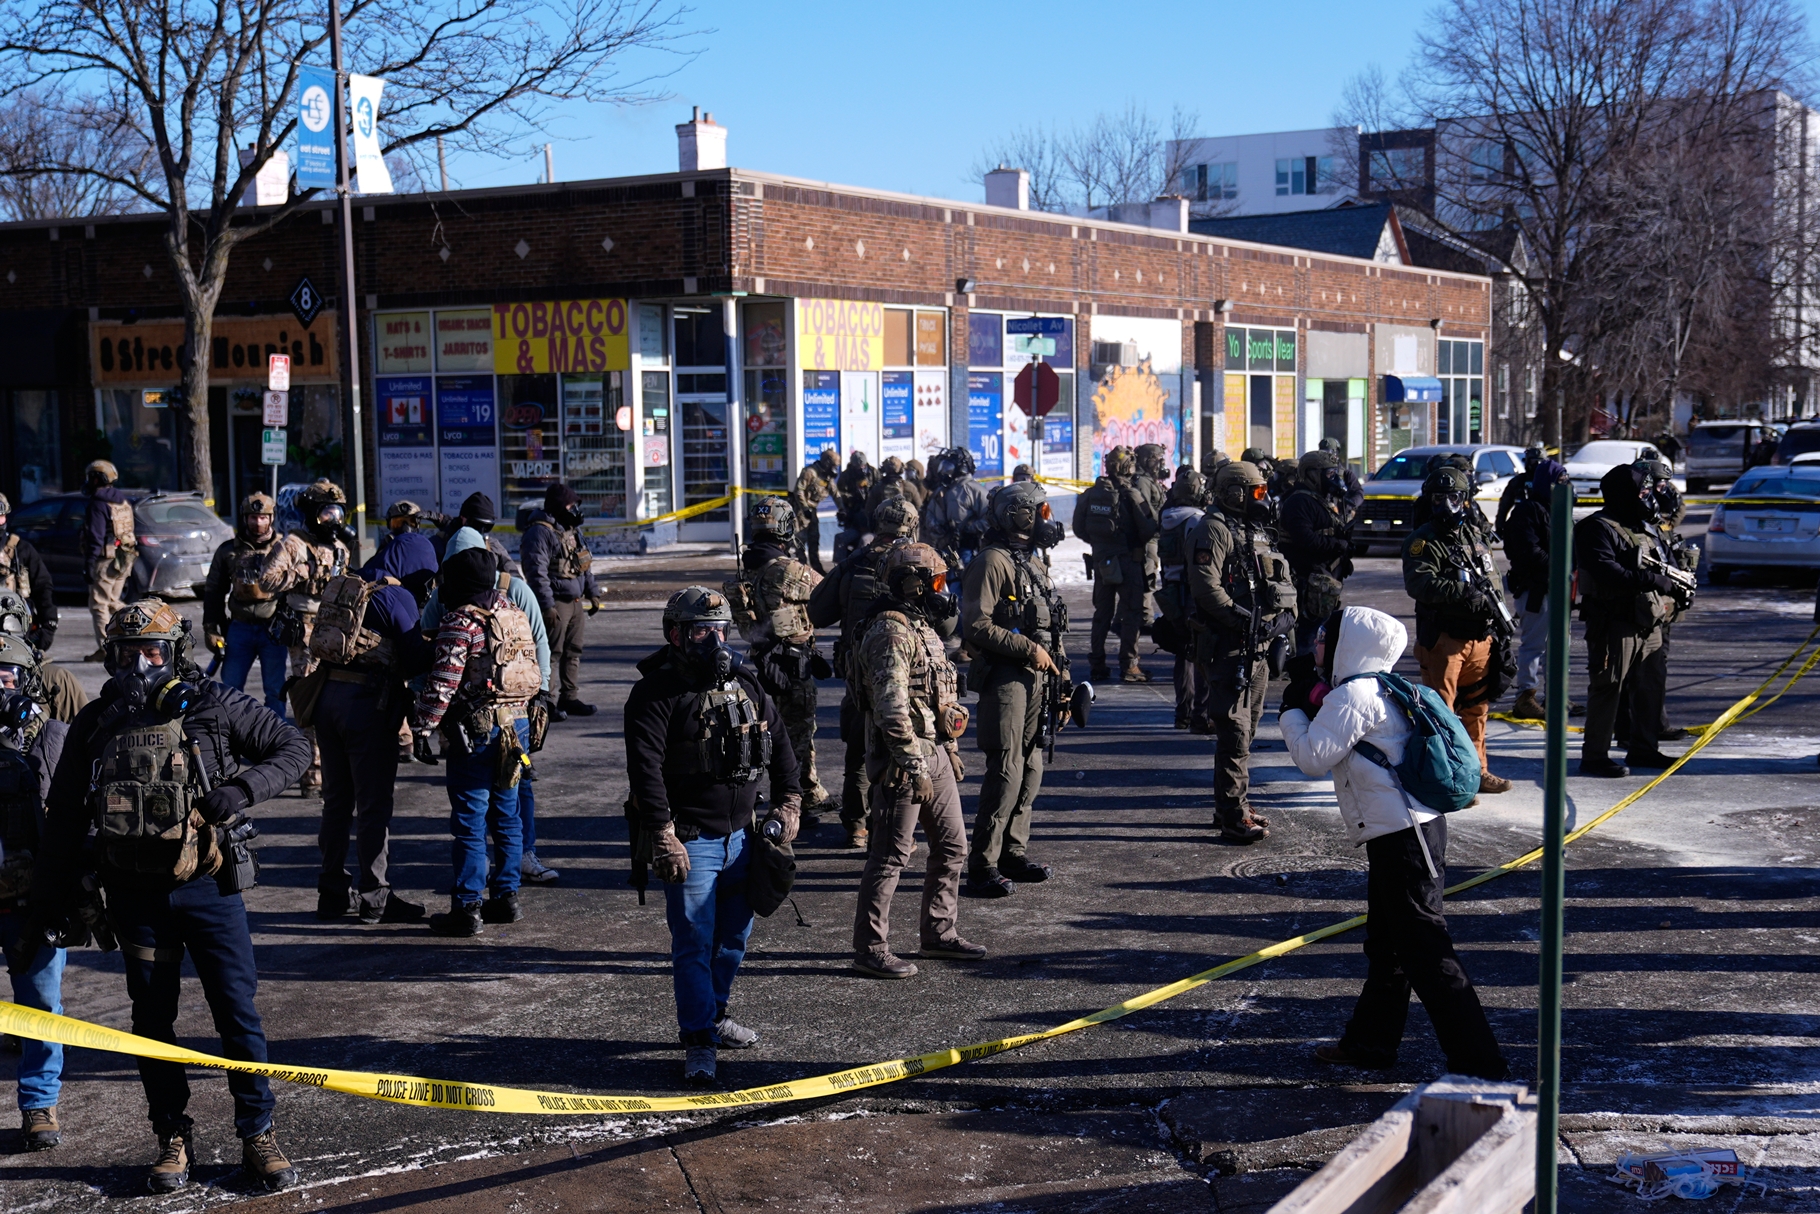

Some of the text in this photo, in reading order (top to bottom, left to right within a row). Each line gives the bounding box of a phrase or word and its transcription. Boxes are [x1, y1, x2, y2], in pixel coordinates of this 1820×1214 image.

[312, 145, 331, 155] street
[301, 287, 311, 310] 8
[494, 299, 625, 339] TOBACCO
[800, 299, 882, 337] TOBACCO
[1007, 320, 1064, 332] Nicollet Av
[382, 346, 427, 360] T-SHIRTS
[443, 342, 489, 356] JARRITOS
[516, 336, 607, 374] & MAS
[815, 335, 871, 371] & MAS
[1228, 333, 1241, 358] Yo
[1248, 335, 1272, 365] Sports
[389, 381, 422, 391] Unlimited
[884, 387, 908, 398] Unlimited
[441, 396, 468, 404] Unlimited
[805, 393, 835, 405] Unlimited
[472, 404, 491, 423] $19
[383, 432, 400, 444] Lyca
[444, 431, 462, 443] Lyca
[981, 434, 999, 459] $10
[383, 452, 433, 460] TOBACCO & MAS
[443, 452, 495, 460] TOBACCO & MAS
[566, 452, 611, 471] GLASS
[448, 464, 470, 472] BONGS
[511, 462, 553, 479] VAPOR
[390, 476, 423, 484] CIGARETTES
[448, 477, 477, 485] HOOKAH
[390, 489, 429, 497] E-CIGARETTES
[449, 490, 462, 498] CBD
[1091, 504, 1111, 512] POLICE
[120, 733, 164, 749] POLICE
[961, 1047, 982, 1061] POLICE
[983, 1045, 998, 1056] LINE
[828, 1058, 925, 1090] POLICE LINE DO NOT CROSS
[375, 1078, 495, 1106] POLICE LINE DO NOT CROSS
[747, 1089, 766, 1101] NOT
[764, 1085, 793, 1100] CROSS
[537, 1095, 652, 1111] POLICE LINE DO NOT CROSS
